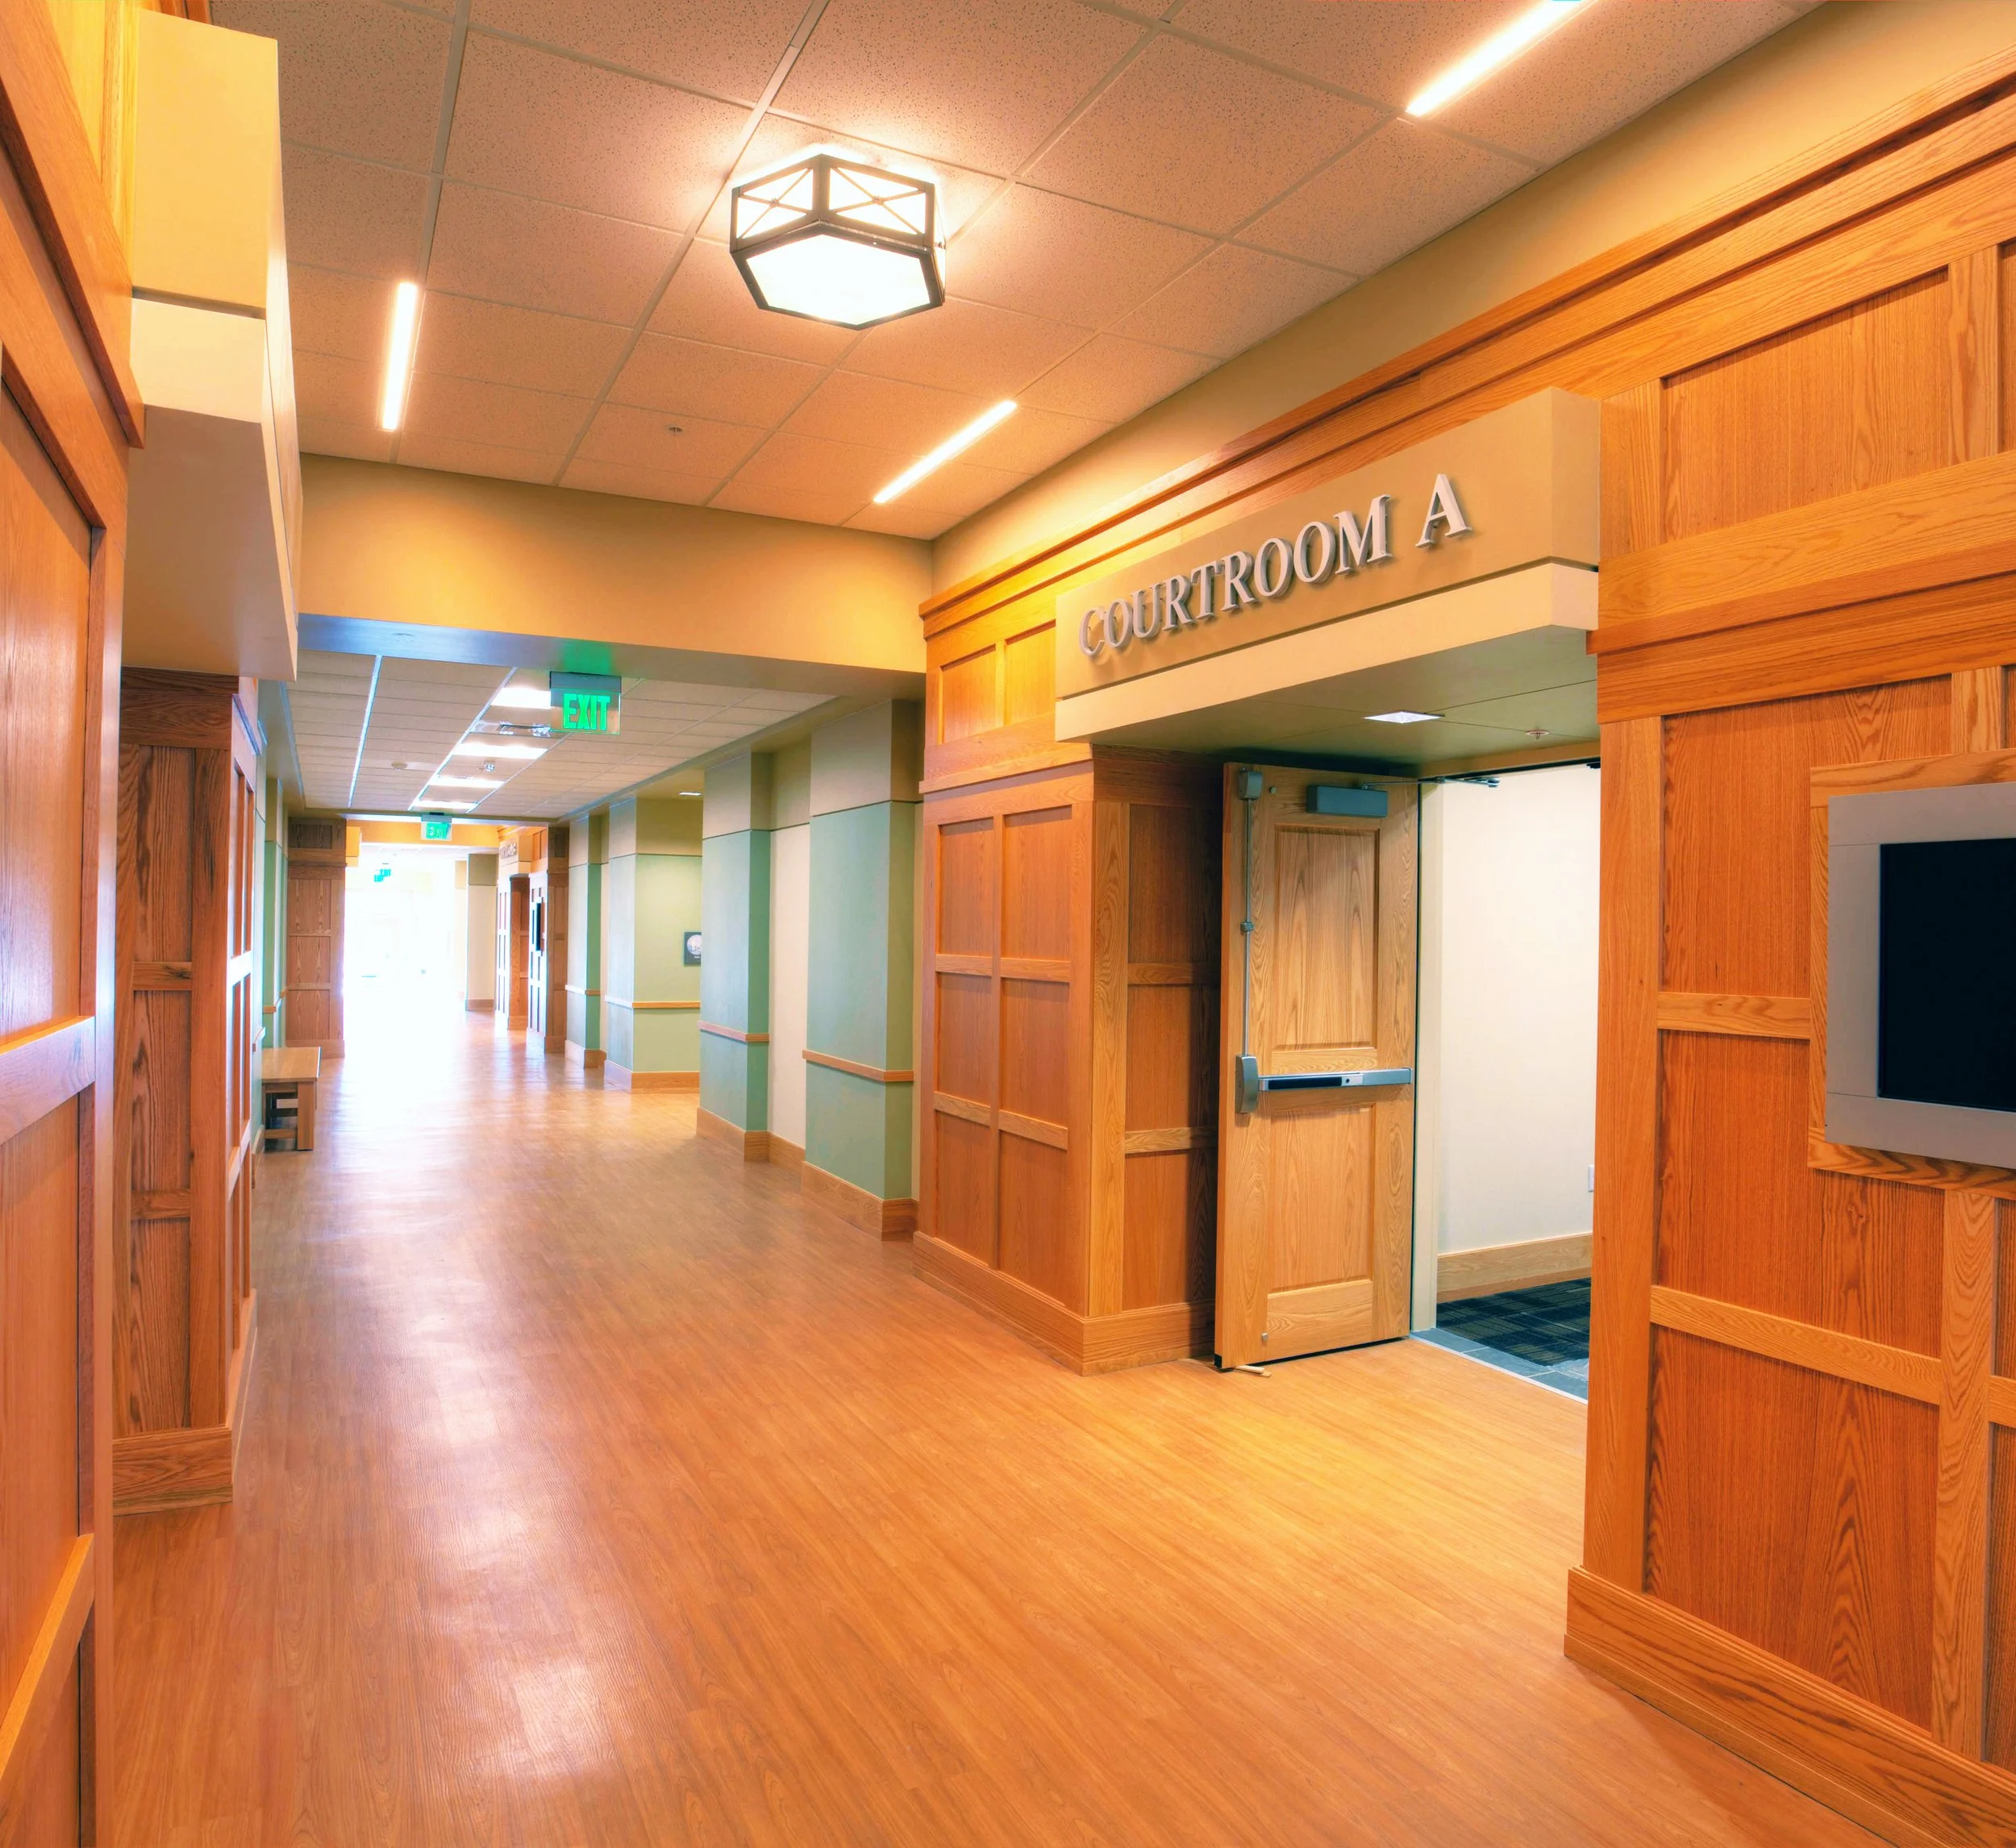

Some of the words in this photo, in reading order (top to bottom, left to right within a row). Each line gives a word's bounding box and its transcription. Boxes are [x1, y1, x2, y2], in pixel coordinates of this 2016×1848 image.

[1079, 494, 1393, 657] COURTROOM
[1415, 473, 1472, 548] A
[563, 693, 610, 730] EXIT
